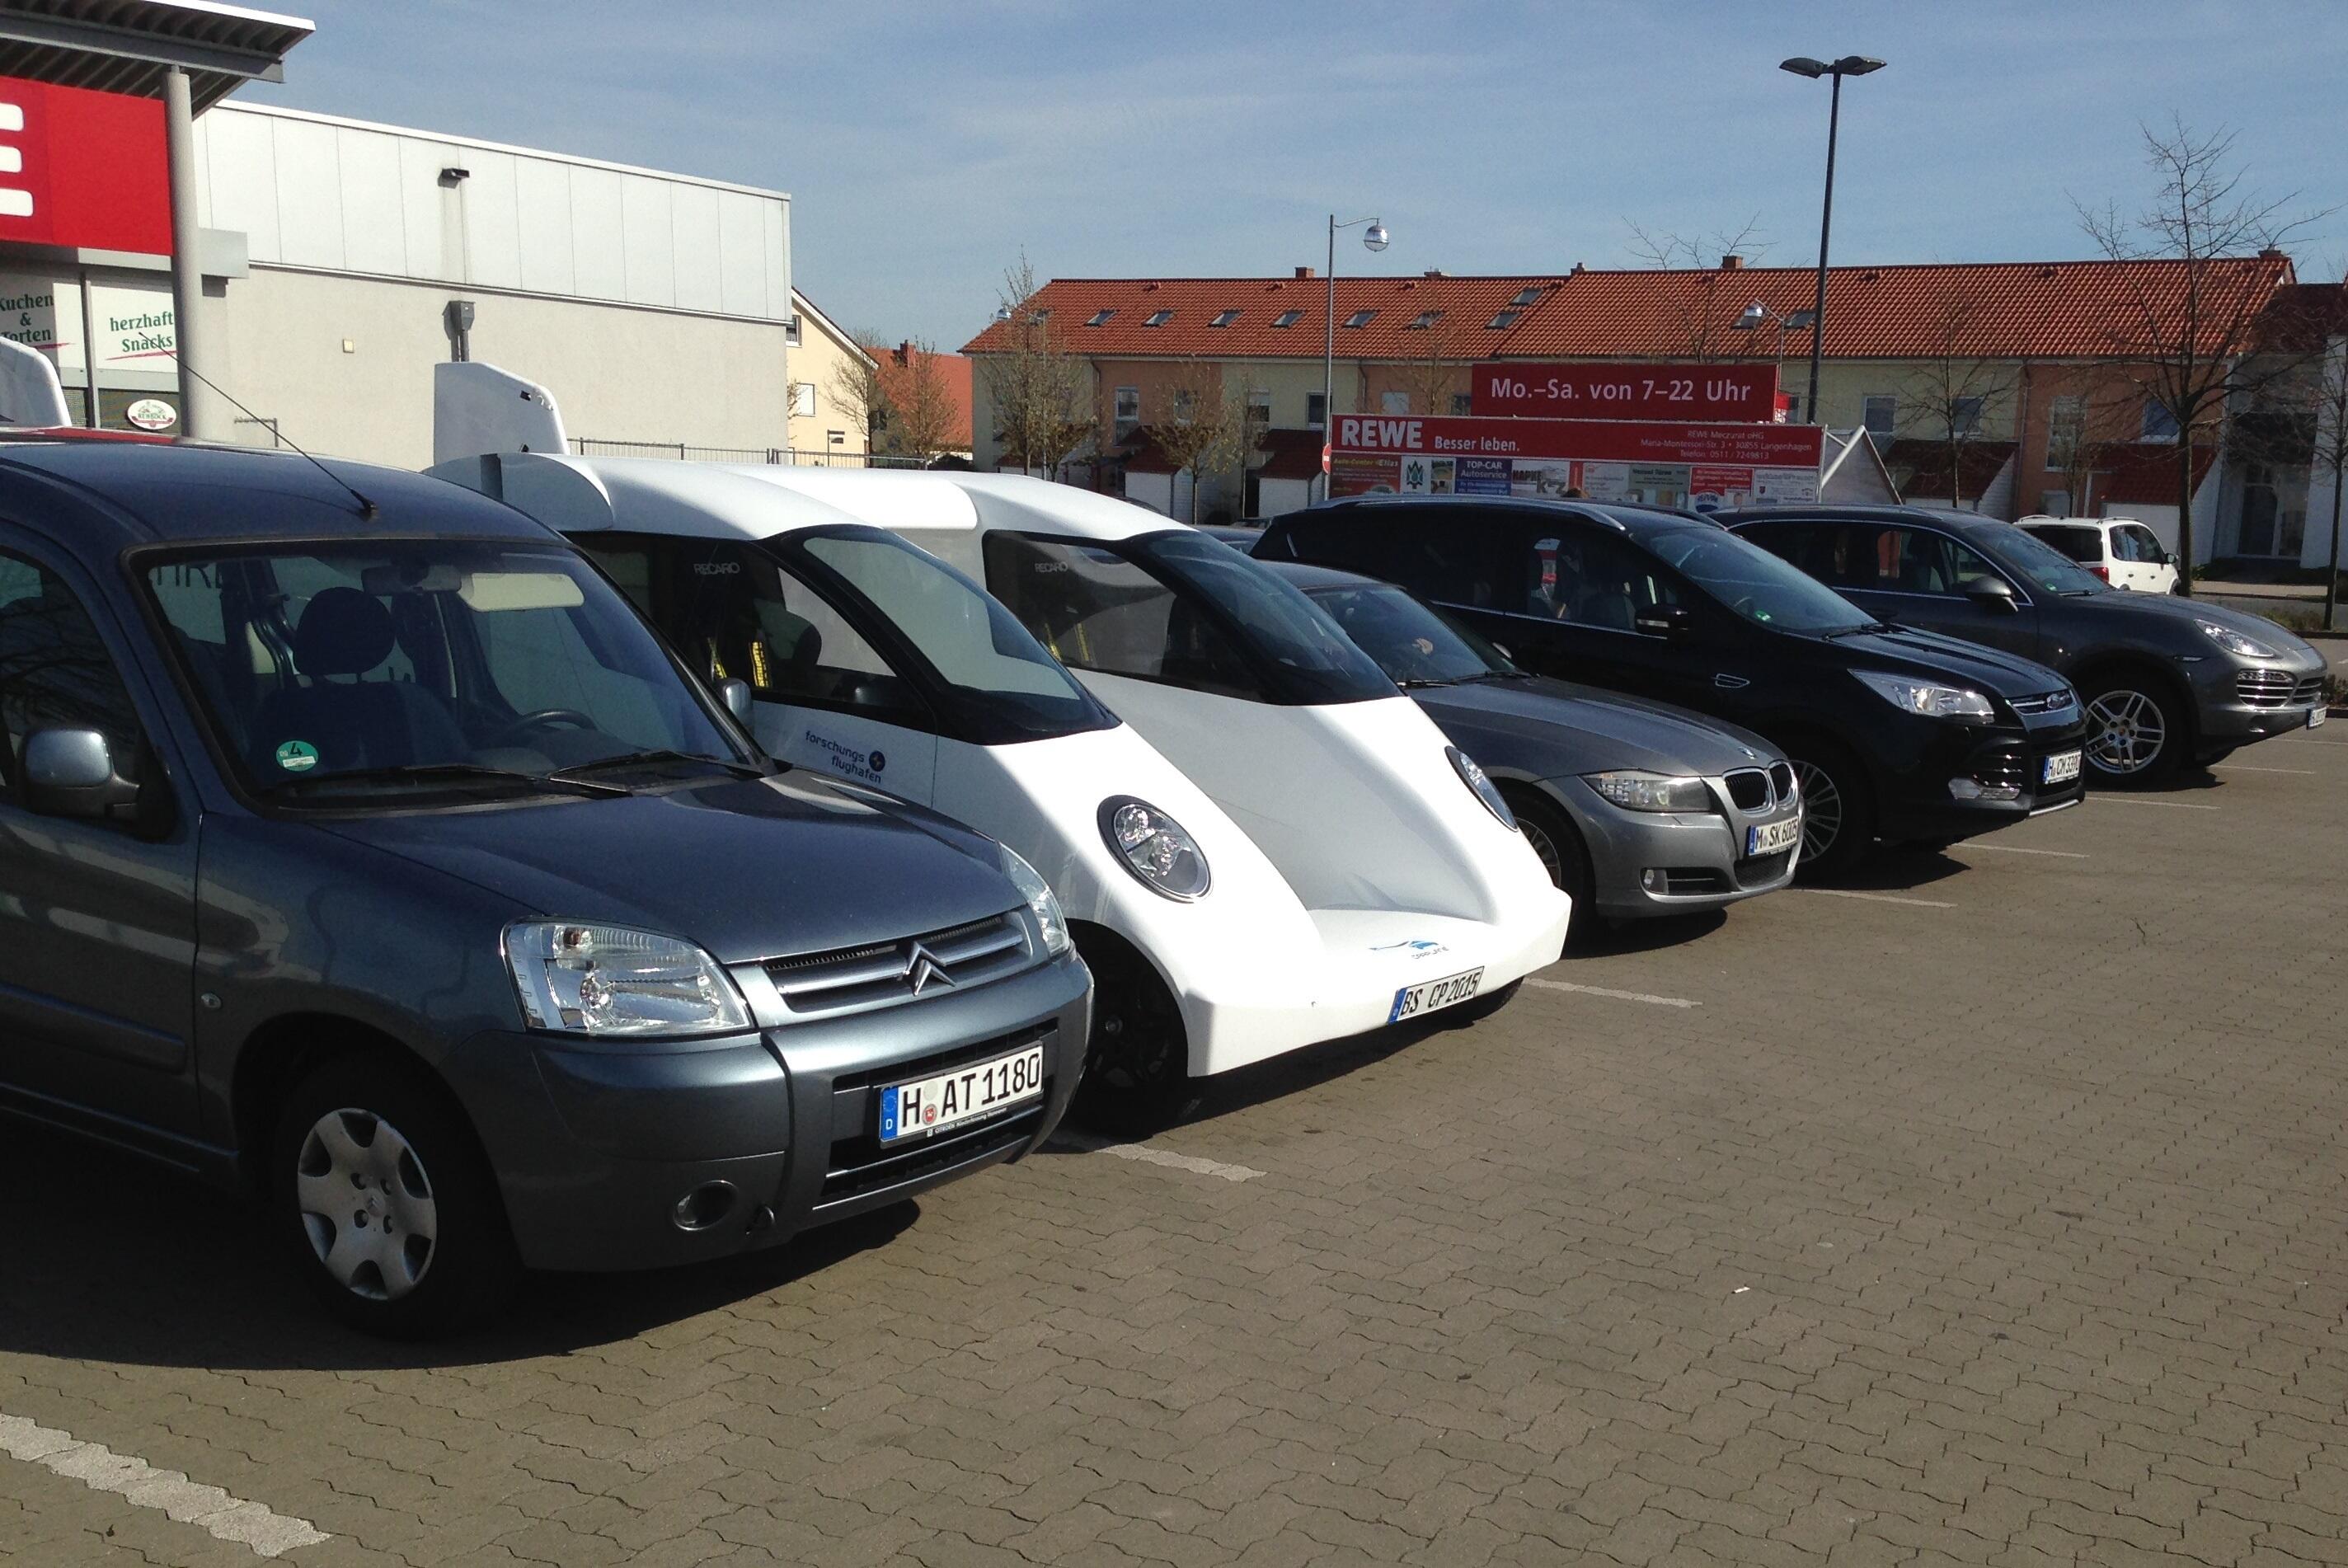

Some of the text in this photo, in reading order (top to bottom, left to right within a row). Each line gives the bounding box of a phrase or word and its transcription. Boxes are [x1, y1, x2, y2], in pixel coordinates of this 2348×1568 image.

[20, 312, 31, 326] &
[110, 311, 174, 331] herzhaft
[122, 334, 173, 352] Snacks
[1590, 383, 1632, 401] von
[1706, 379, 1751, 401] Uhr
[1341, 419, 1520, 452] REWE Besser leben.
[1761, 442, 1812, 452] Langenhagen
[1466, 460, 1503, 470] TOP-CAR
[1460, 469, 1507, 480] Autoservice
[693, 561, 740, 575] RECARO
[1035, 561, 1068, 573] RECARO
[290, 742, 303, 756] 4
[805, 730, 865, 763] forschungs
[831, 754, 881, 784] flughafen
[1400, 988, 1424, 1016] BS
[903, 1087, 922, 1128] H
